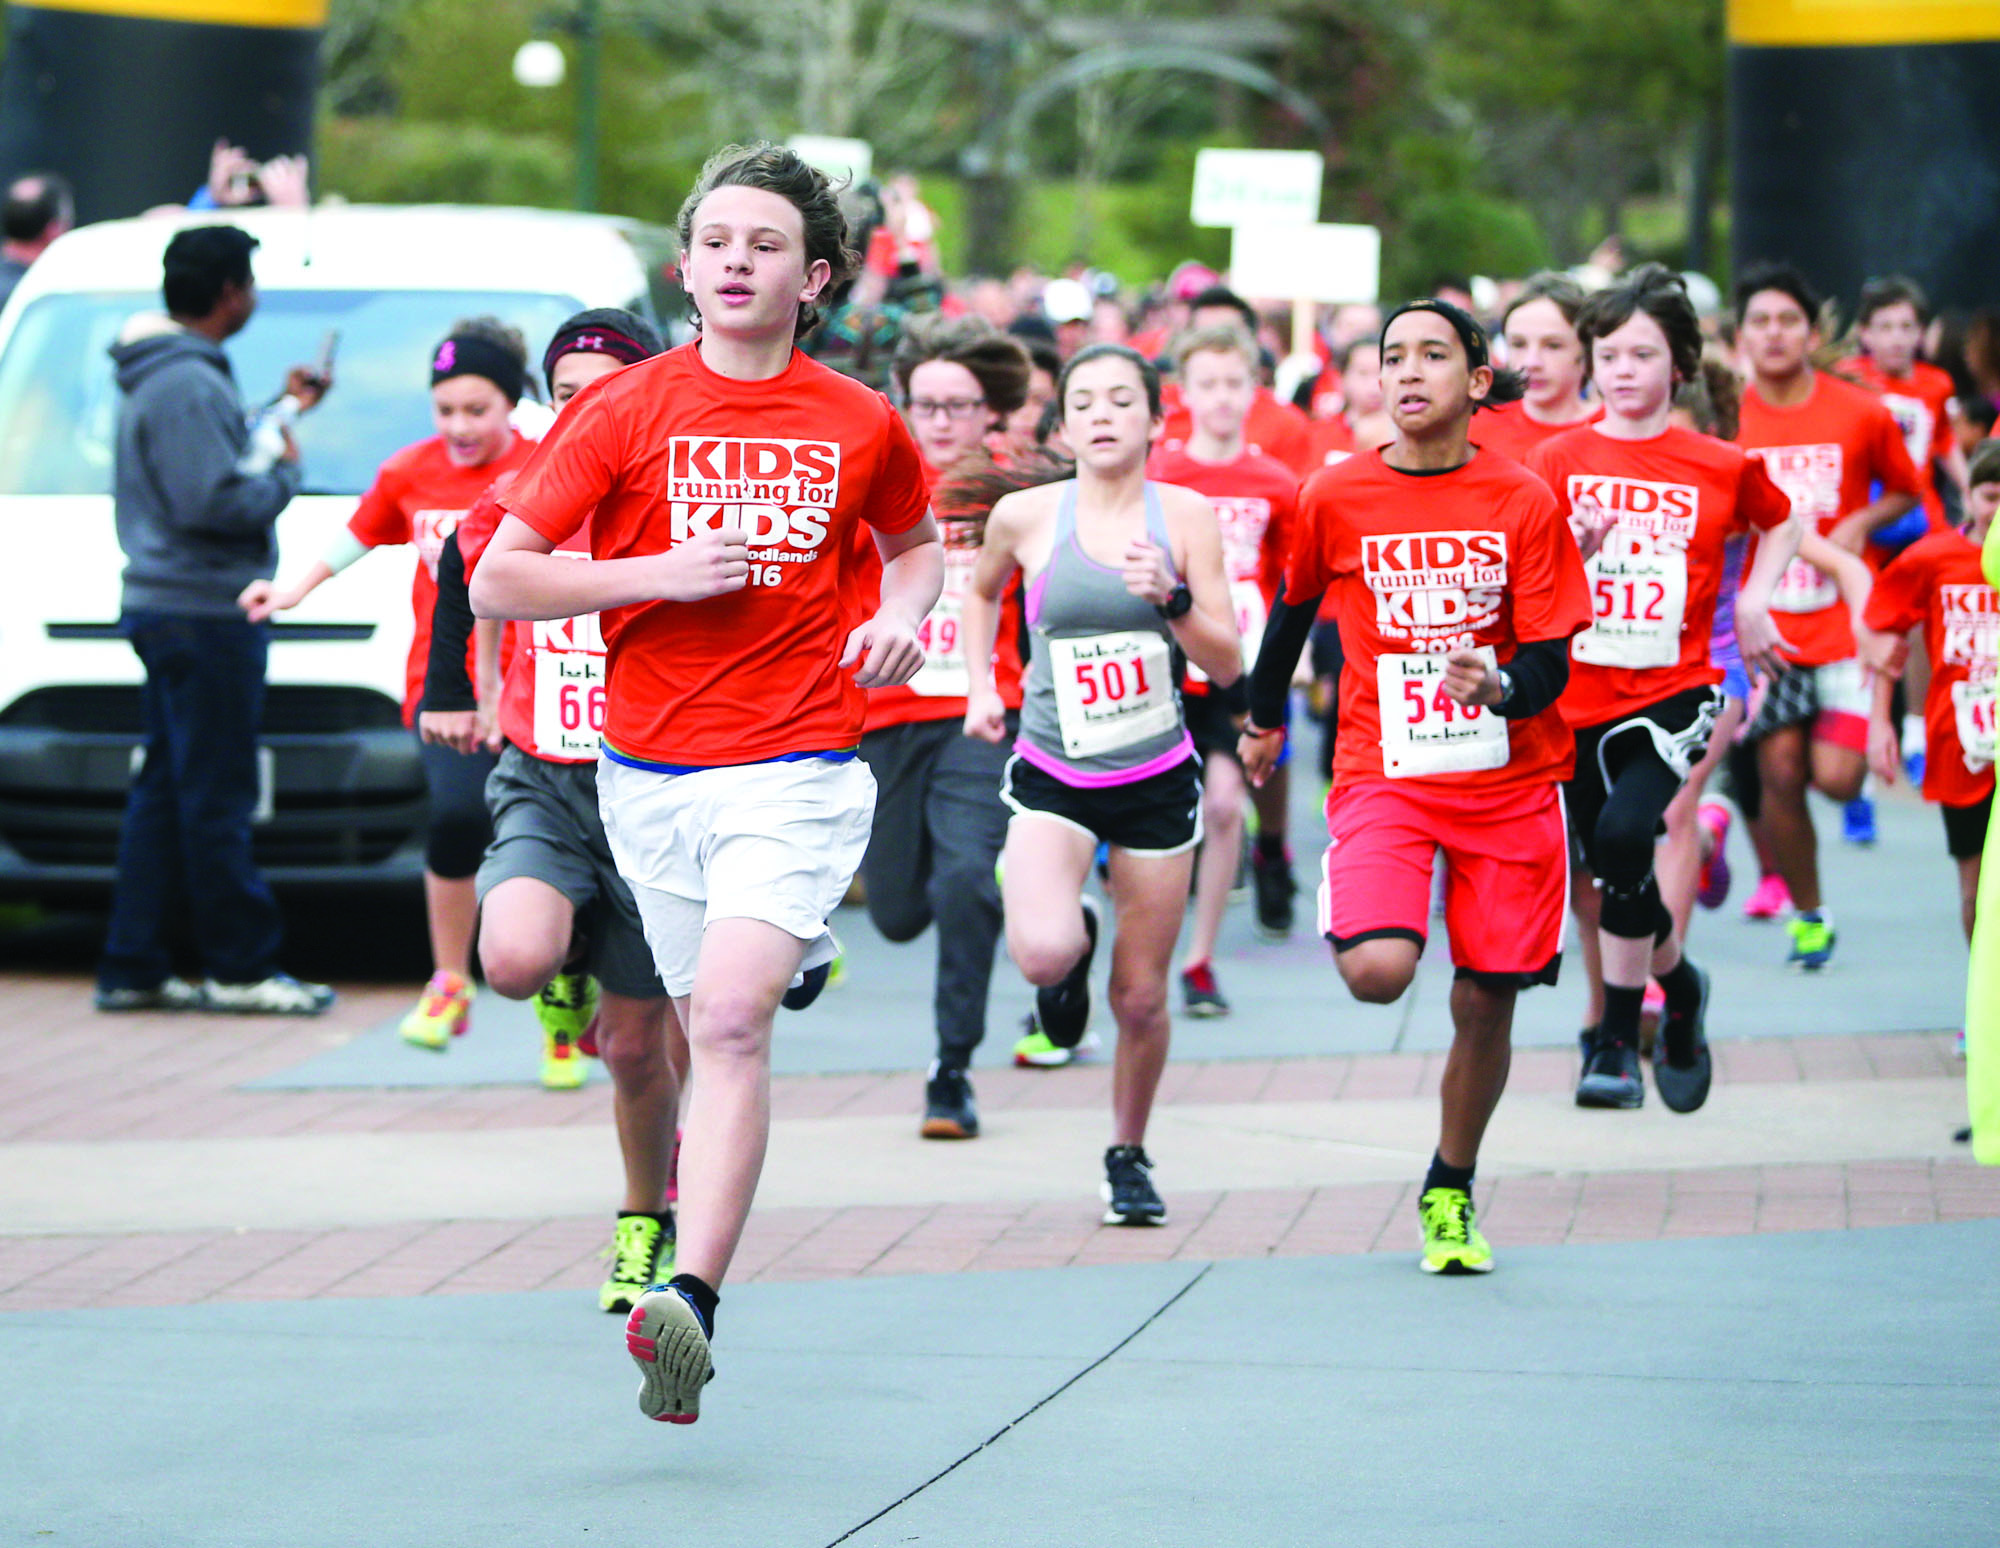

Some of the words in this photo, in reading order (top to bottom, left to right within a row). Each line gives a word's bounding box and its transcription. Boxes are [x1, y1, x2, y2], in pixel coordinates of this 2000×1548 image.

[673, 440, 836, 484] KIDS
[672, 473, 791, 505] running
[797, 477, 834, 503] for
[1574, 481, 1693, 518] KIDS
[747, 547, 818, 564] odlands
[1366, 535, 1504, 572] KIDS
[747, 563, 783, 587] 16
[1472, 565, 1502, 584] for
[1375, 587, 1501, 627] KIDS
[1595, 579, 1665, 621] 512
[1946, 591, 2000, 613] KI
[1376, 622, 1409, 639] The
[1075, 656, 1150, 705] 501
[560, 684, 607, 732] 66
